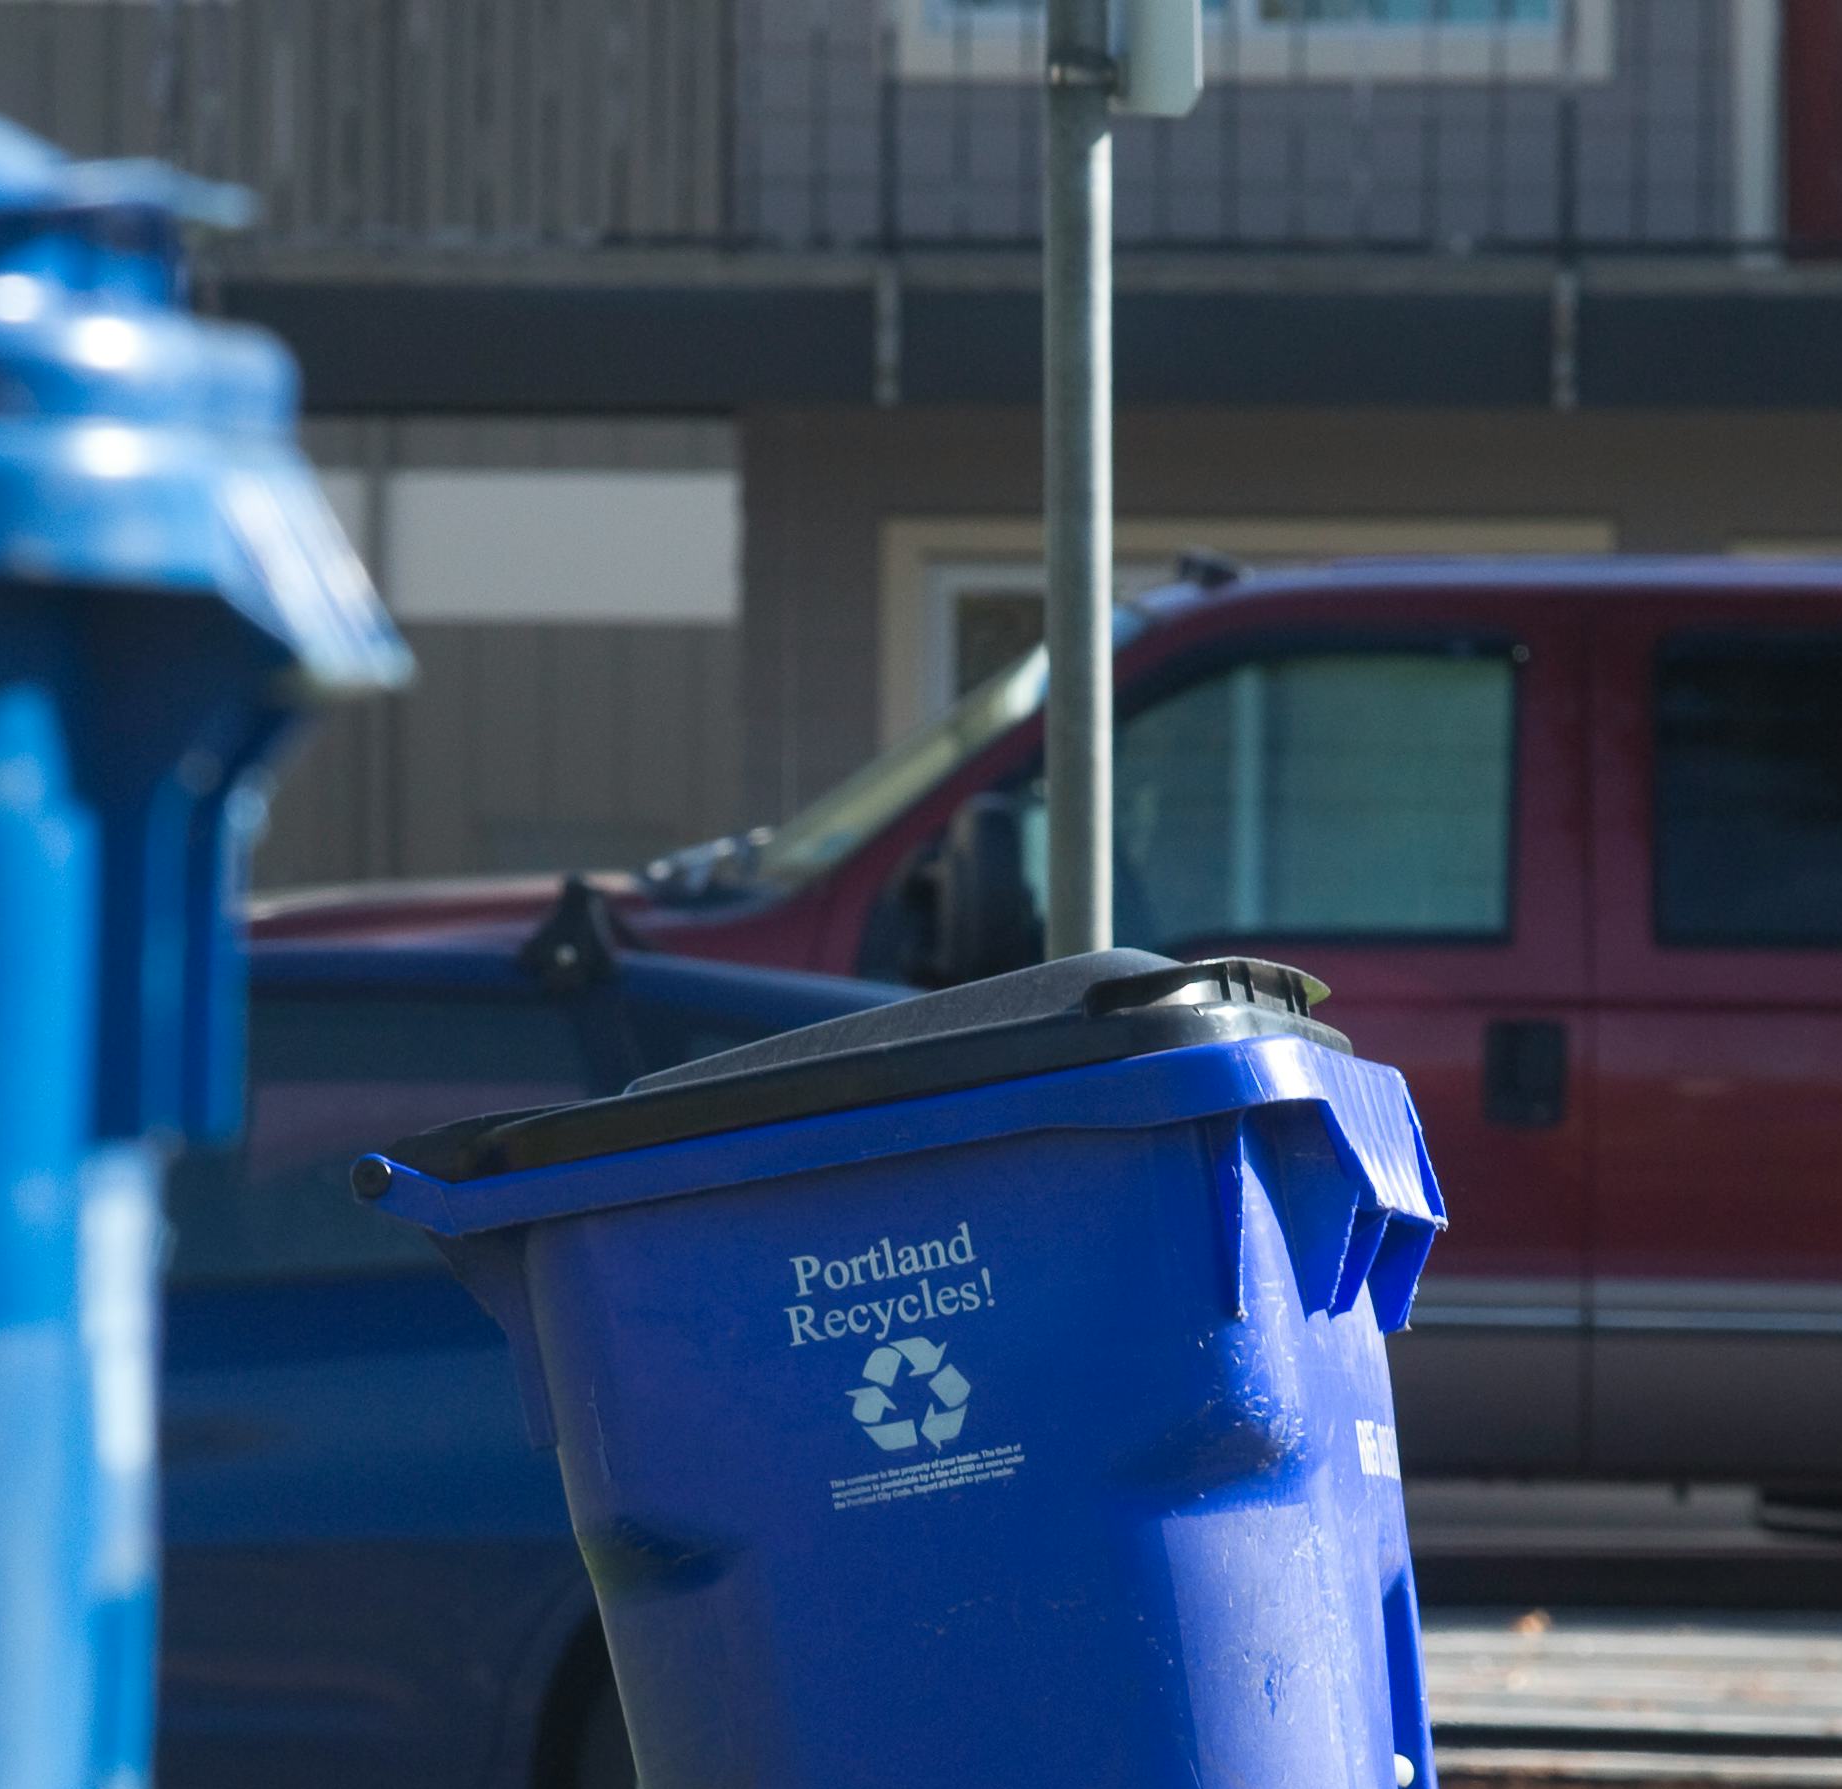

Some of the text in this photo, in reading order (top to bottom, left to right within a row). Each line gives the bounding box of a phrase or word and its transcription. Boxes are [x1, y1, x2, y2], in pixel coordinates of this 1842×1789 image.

[789, 1221, 977, 1297] Portland
[783, 1267, 995, 1347] Recycles!
[981, 1450, 995, 1458] The
